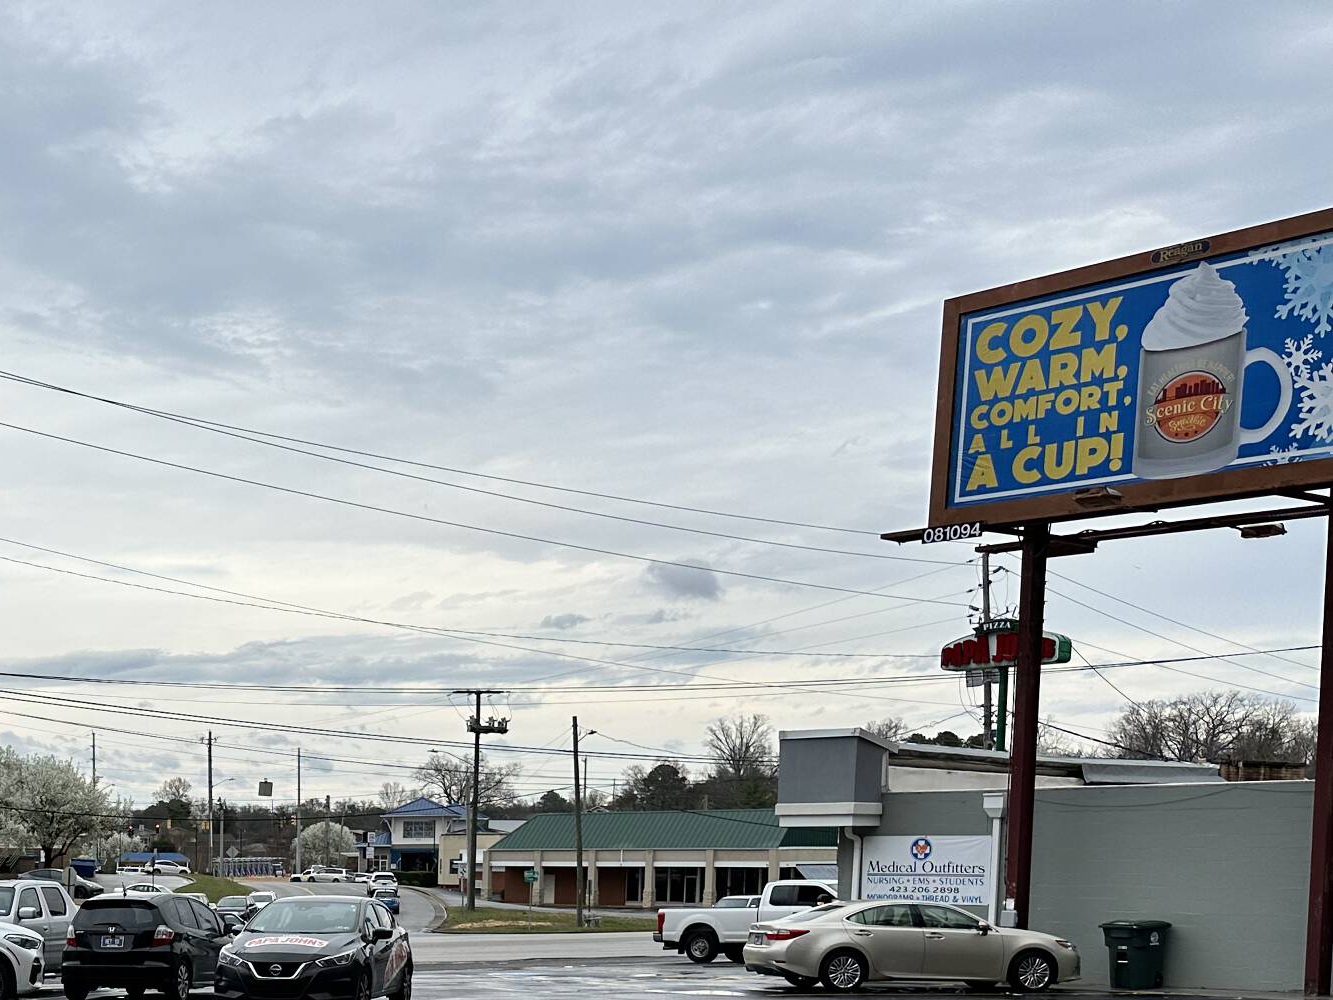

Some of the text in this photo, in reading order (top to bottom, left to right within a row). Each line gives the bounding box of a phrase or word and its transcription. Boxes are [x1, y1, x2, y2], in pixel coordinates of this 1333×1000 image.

[1161, 243, 1202, 261] Reagan
[975, 296, 1129, 364] COZY,
[974, 342, 1128, 401] WARM,
[970, 380, 1132, 429] COMFORT,
[1146, 394, 1234, 427] Scenic City
[968, 410, 1119, 454] ALL IN
[966, 432, 1124, 491] A CUP!
[924, 522, 981, 543] 081094
[983, 621, 1011, 631] PIZZA
[867, 861, 986, 874] Medical Outfitters
[867, 877, 985, 886] NURSING EMS STUDENTS
[911, 886, 930, 894] 206
[932, 886, 960, 894] 2898
[922, 895, 950, 903] THREAD
[952, 895, 960, 903] &
[961, 895, 984, 904] VINYL
